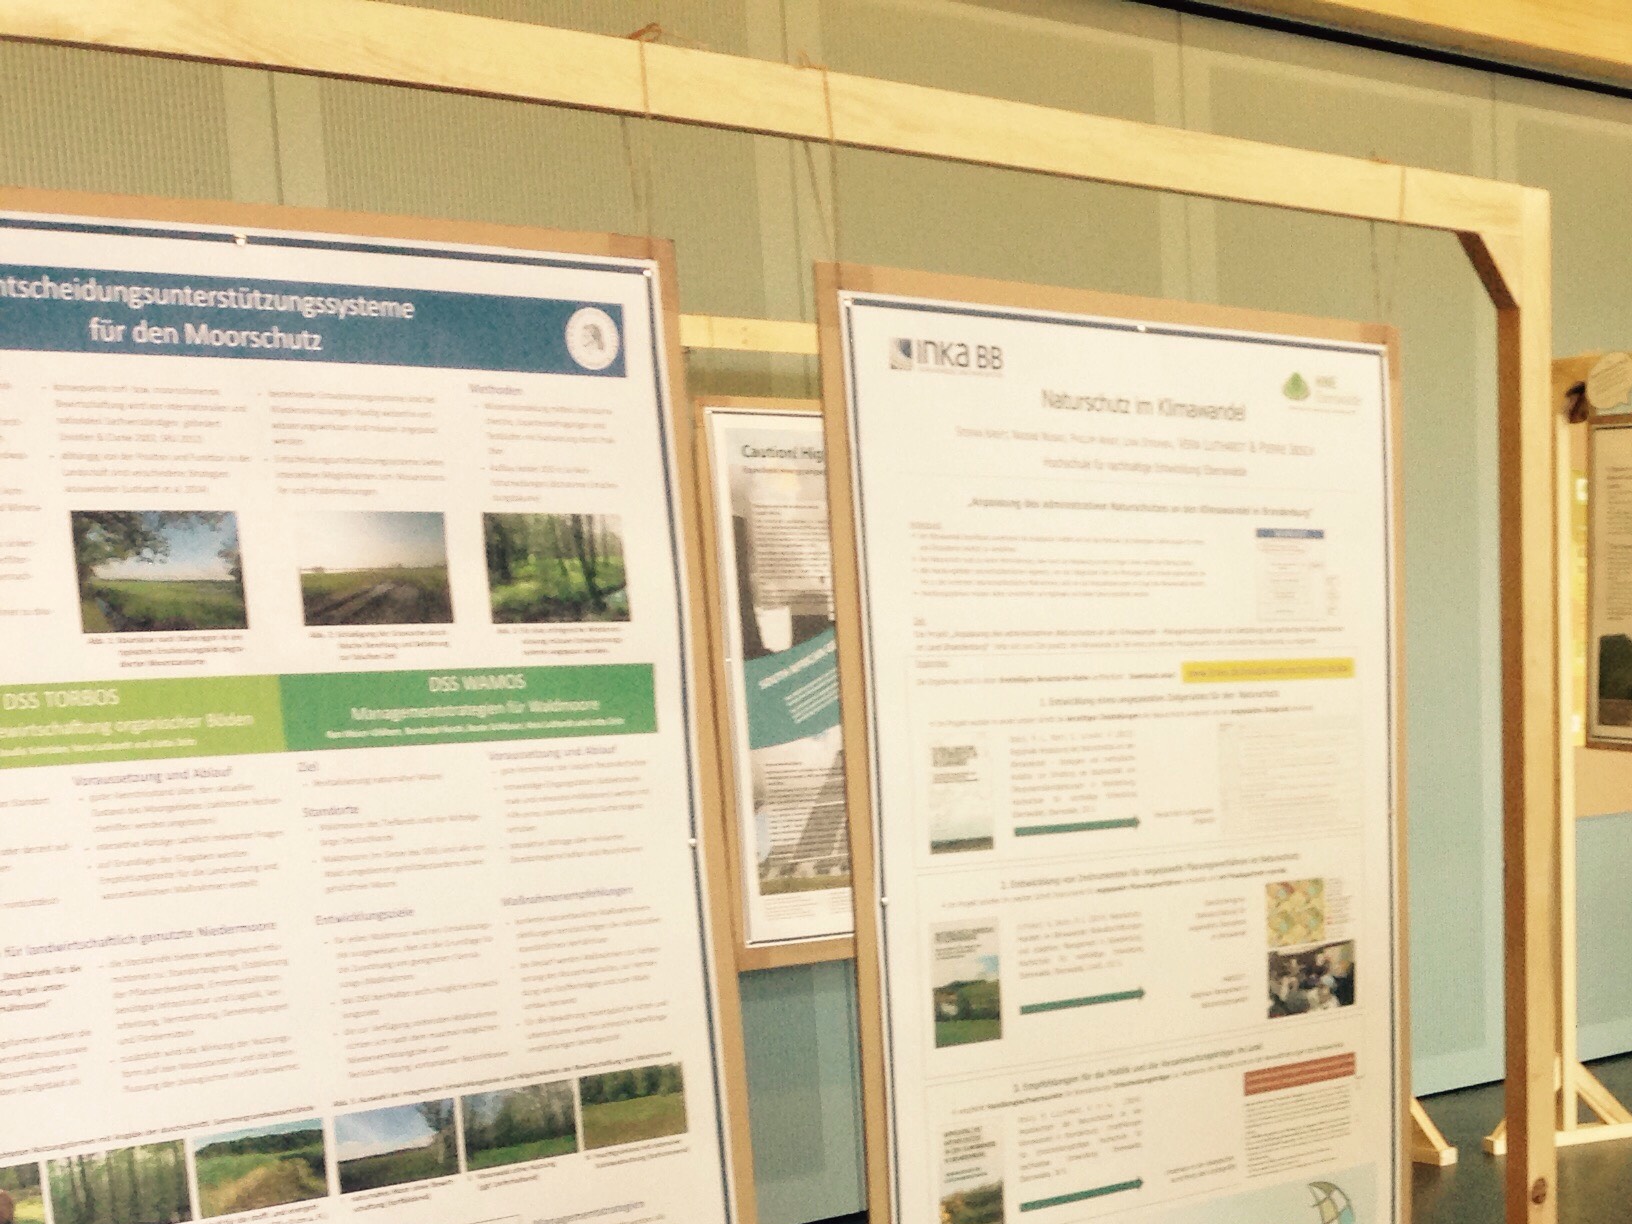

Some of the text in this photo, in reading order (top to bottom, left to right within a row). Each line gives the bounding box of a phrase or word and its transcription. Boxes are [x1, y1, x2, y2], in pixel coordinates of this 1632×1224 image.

[91, 317, 322, 351] für den Moorschutz
[976, 344, 1004, 371] BB
[1042, 389, 1246, 422] Naturschutz im Klimawandel
[430, 677, 460, 692] DSS
[3, 693, 39, 710] DSS
